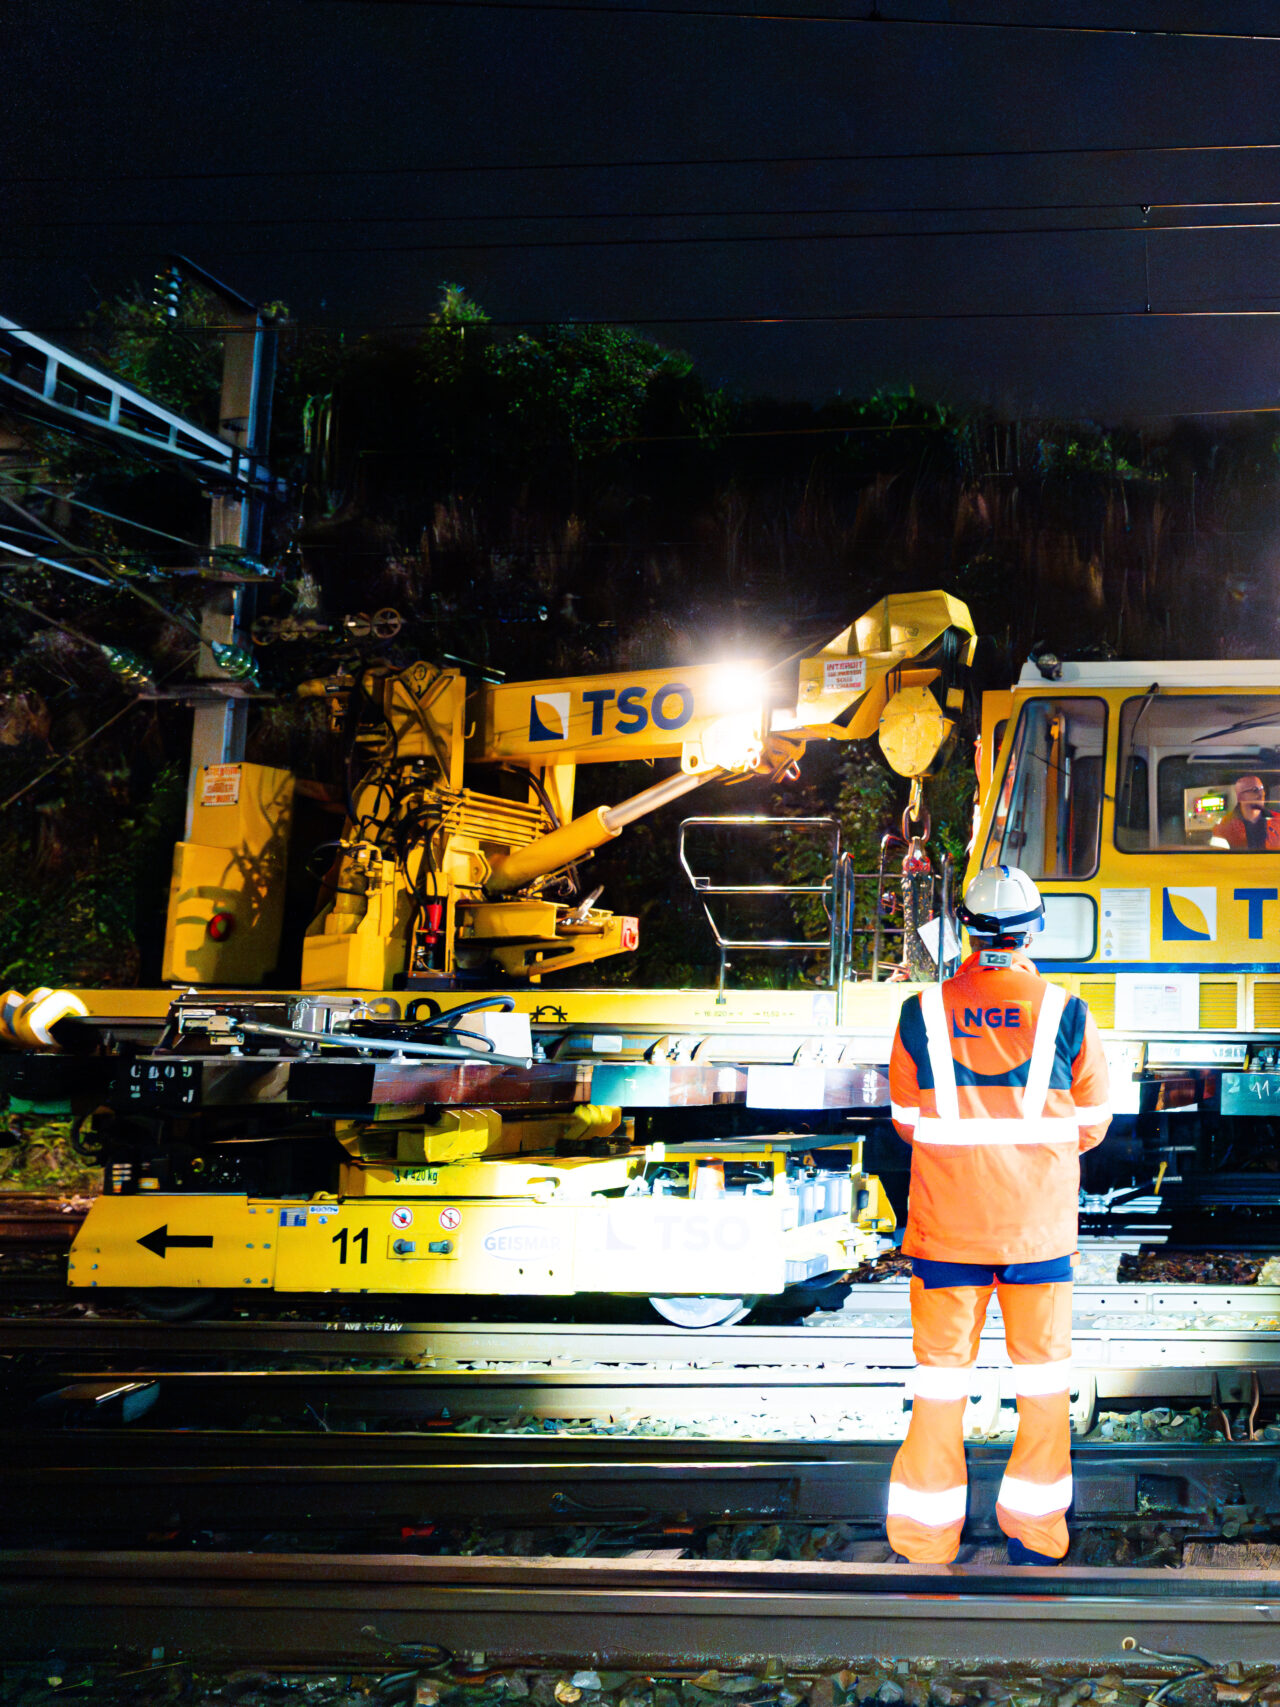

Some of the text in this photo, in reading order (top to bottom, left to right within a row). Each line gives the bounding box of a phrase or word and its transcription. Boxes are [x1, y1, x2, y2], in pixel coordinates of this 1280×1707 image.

[582, 683, 695, 736] TSO
[964, 1007, 1021, 1028] NGE
[332, 1227, 369, 1265] 11
[484, 1235, 562, 1252] GEISMAR
[653, 1215, 751, 1252] TSO
